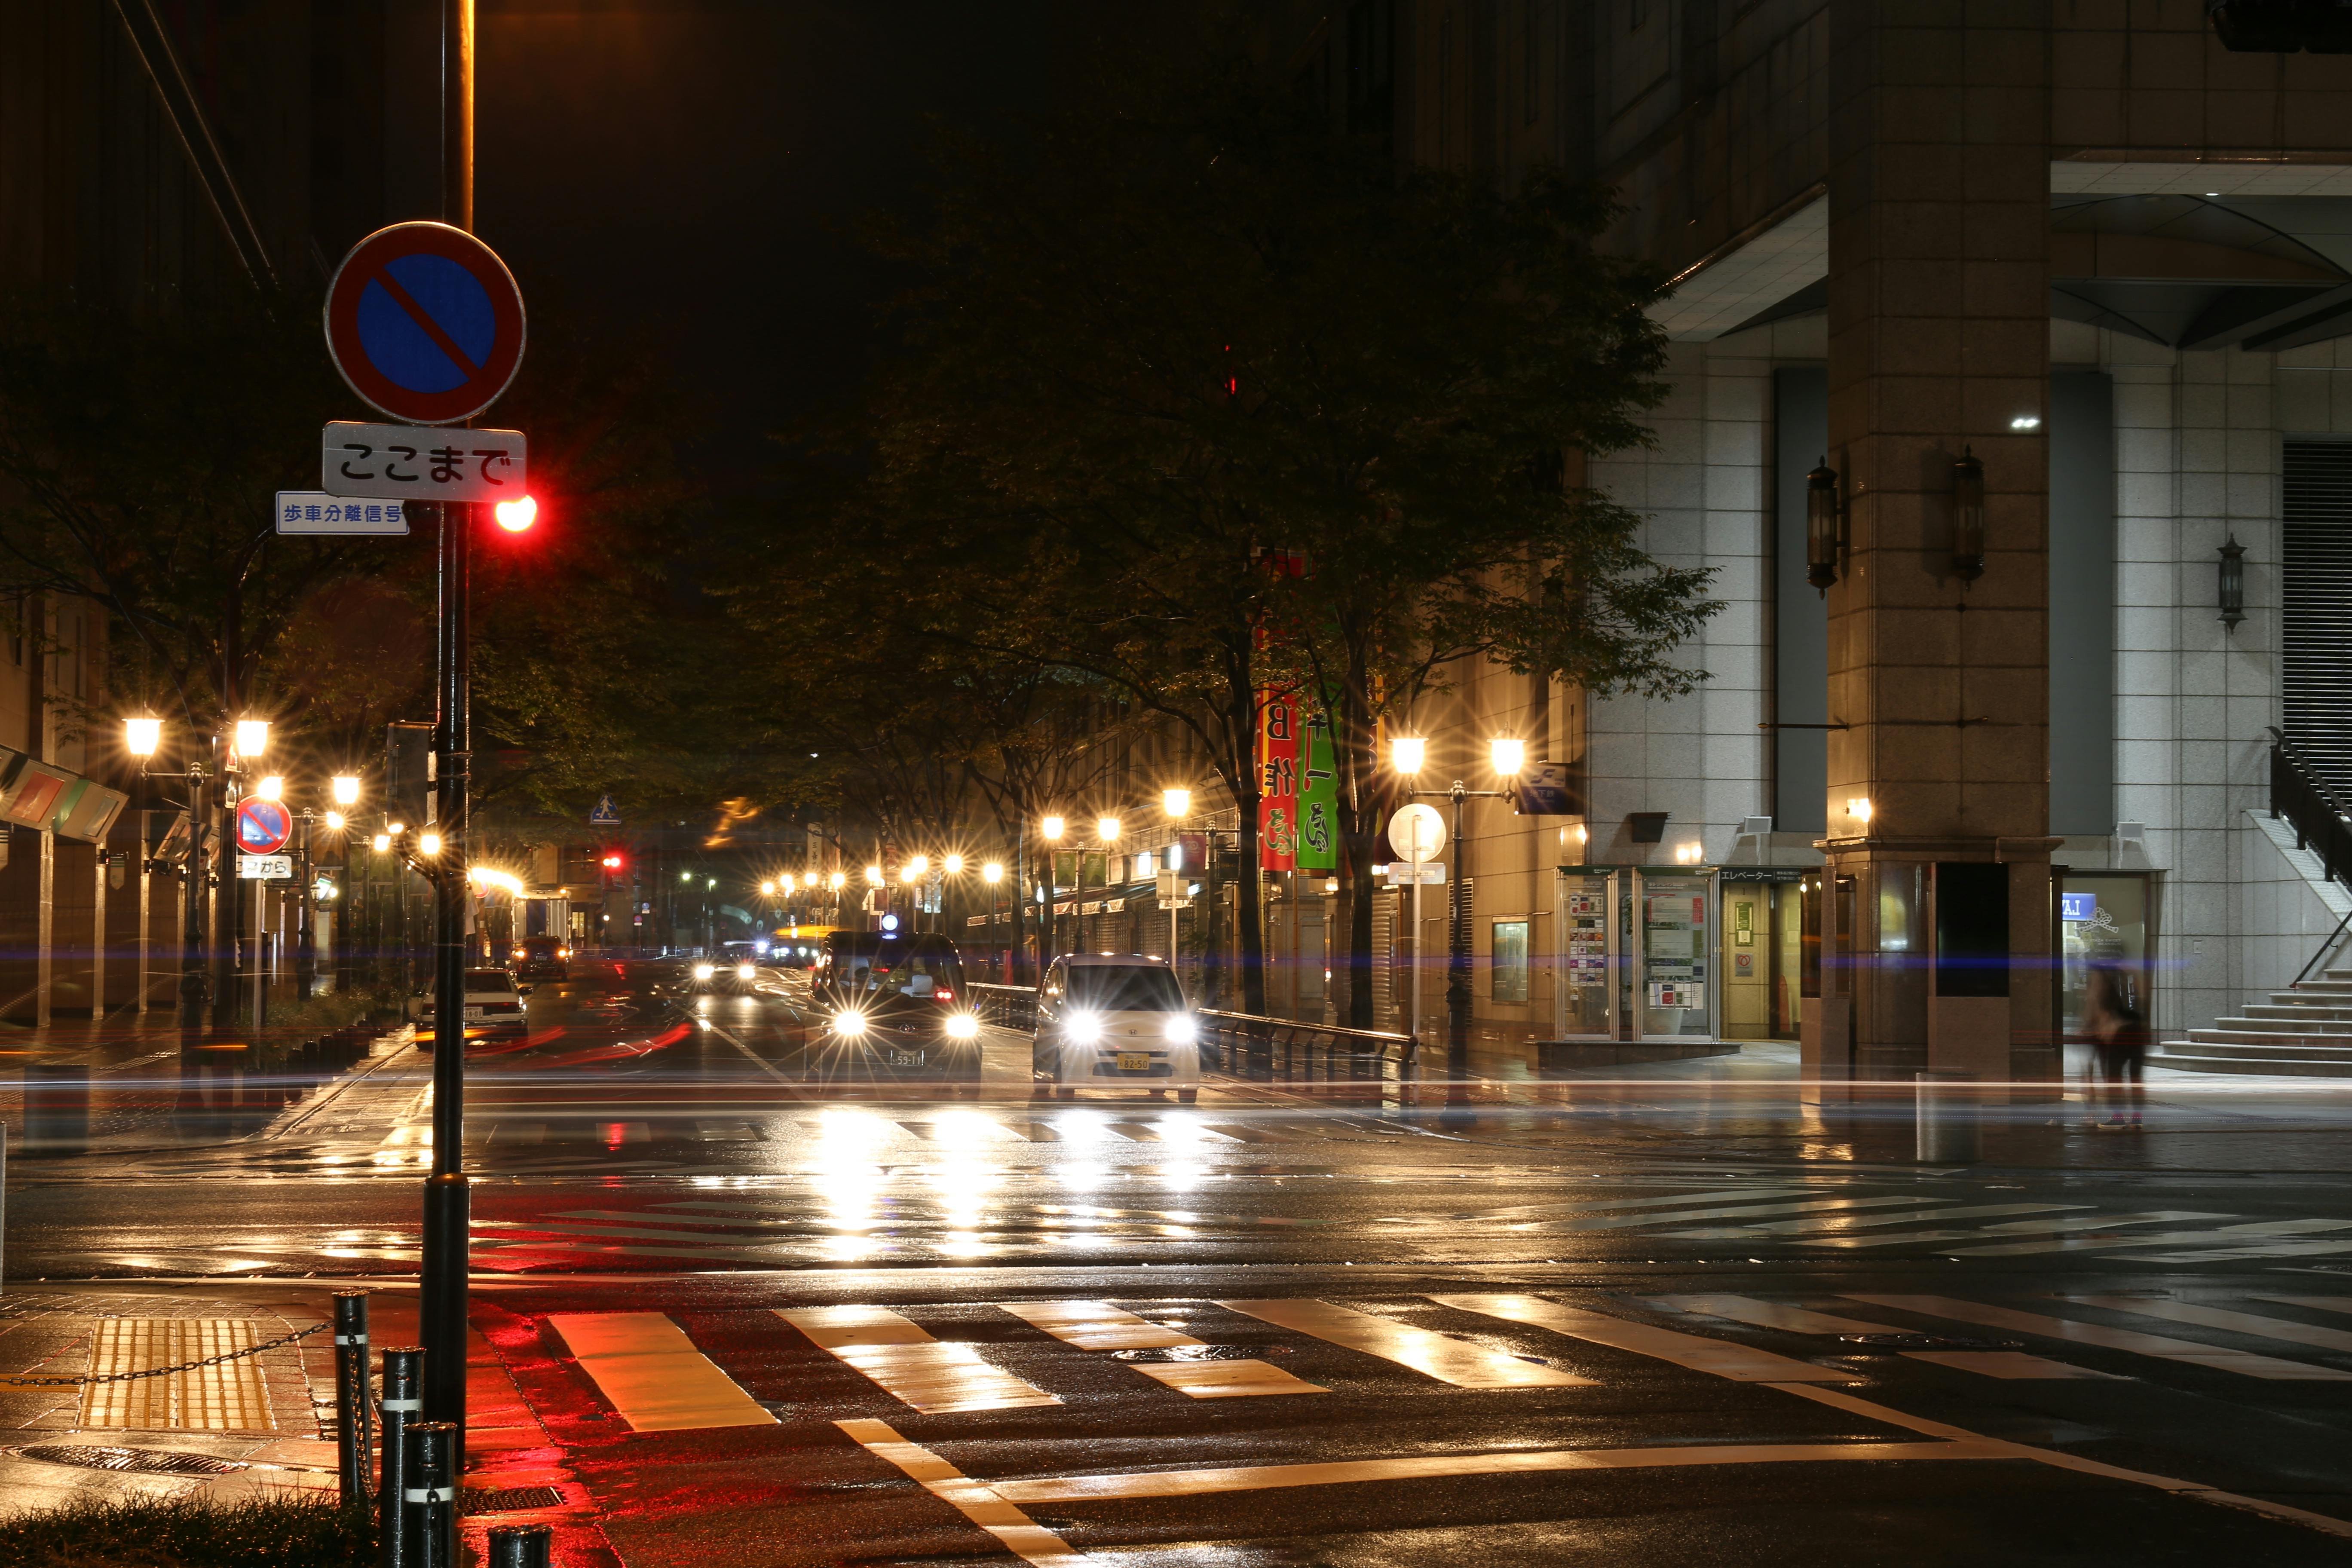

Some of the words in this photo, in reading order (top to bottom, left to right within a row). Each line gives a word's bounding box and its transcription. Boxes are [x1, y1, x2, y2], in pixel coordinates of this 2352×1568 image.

[341, 443, 511, 485] ここまで
[284, 505, 401, 523] 歩車分離信号
[1530, 790, 1555, 798] 地下鉄
[1721, 871, 1772, 880] エレベーター
[897, 1056, 920, 1065] 59-11
[1124, 1060, 1148, 1069] 82-50
